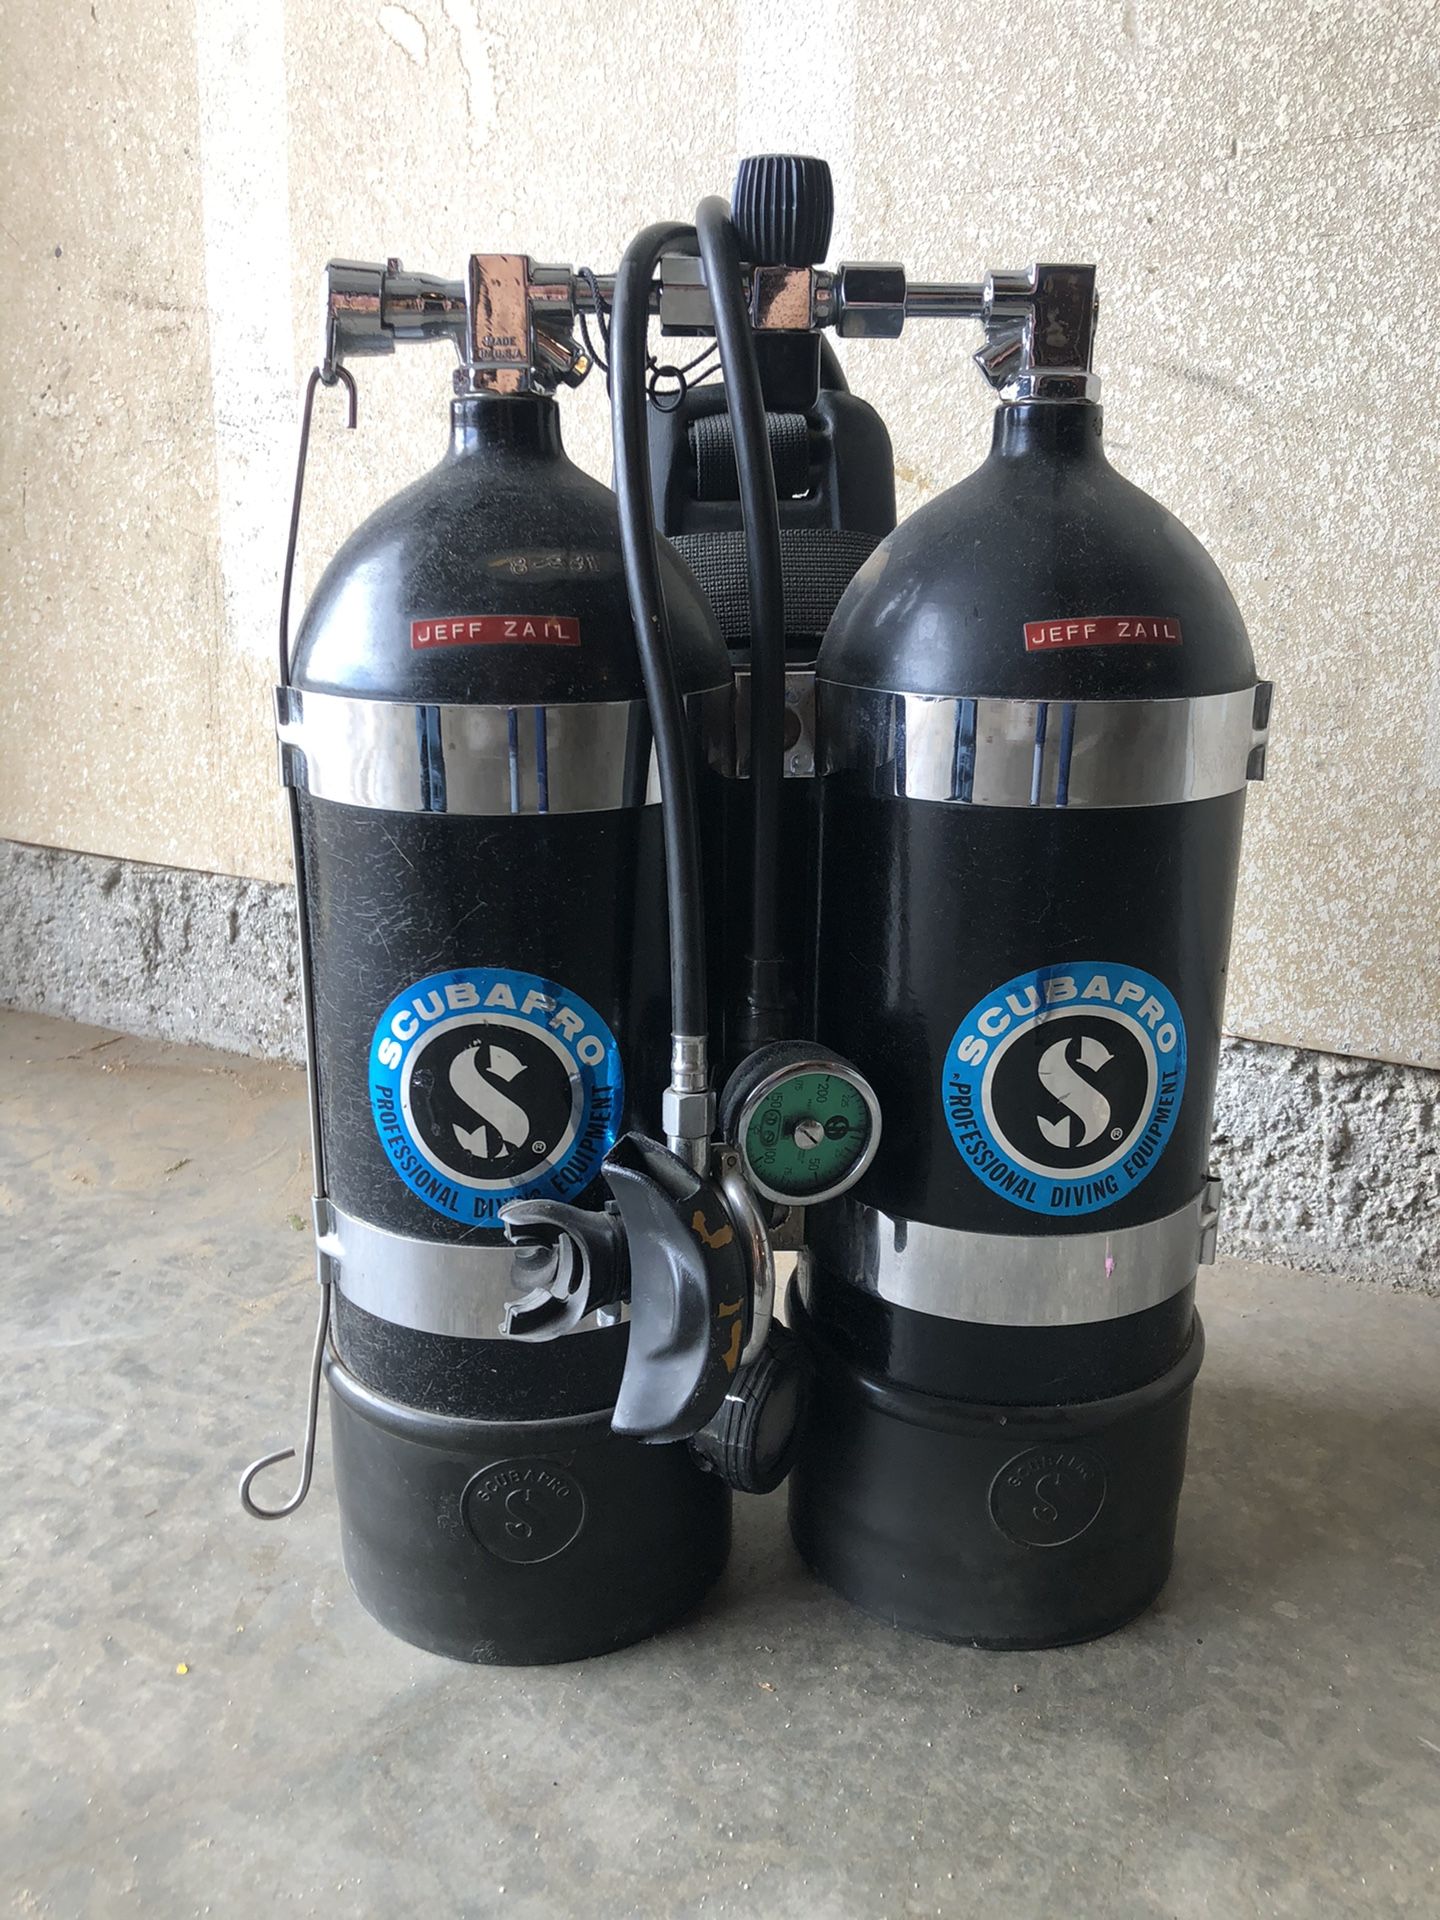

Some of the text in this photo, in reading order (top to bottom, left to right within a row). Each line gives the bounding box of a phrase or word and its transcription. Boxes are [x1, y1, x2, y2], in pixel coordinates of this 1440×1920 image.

[418, 621, 570, 642] JEFF ZAIL
[1032, 622, 1176, 644] JEFF ZAIL
[377, 983, 605, 1070] SCUBAPRO
[957, 975, 1177, 1066] SCUBAPRO
[771, 1092, 783, 1108] 150
[816, 1083, 829, 1104] 200
[374, 1084, 460, 1213] PROFESSIONAL
[550, 1085, 613, 1195] EQUIPMENT
[949, 1071, 1178, 1208] PROFESSIONAL DIVING EQUIPMENT
[764, 1149, 775, 1164] 100
[808, 1158, 820, 1171] 50
